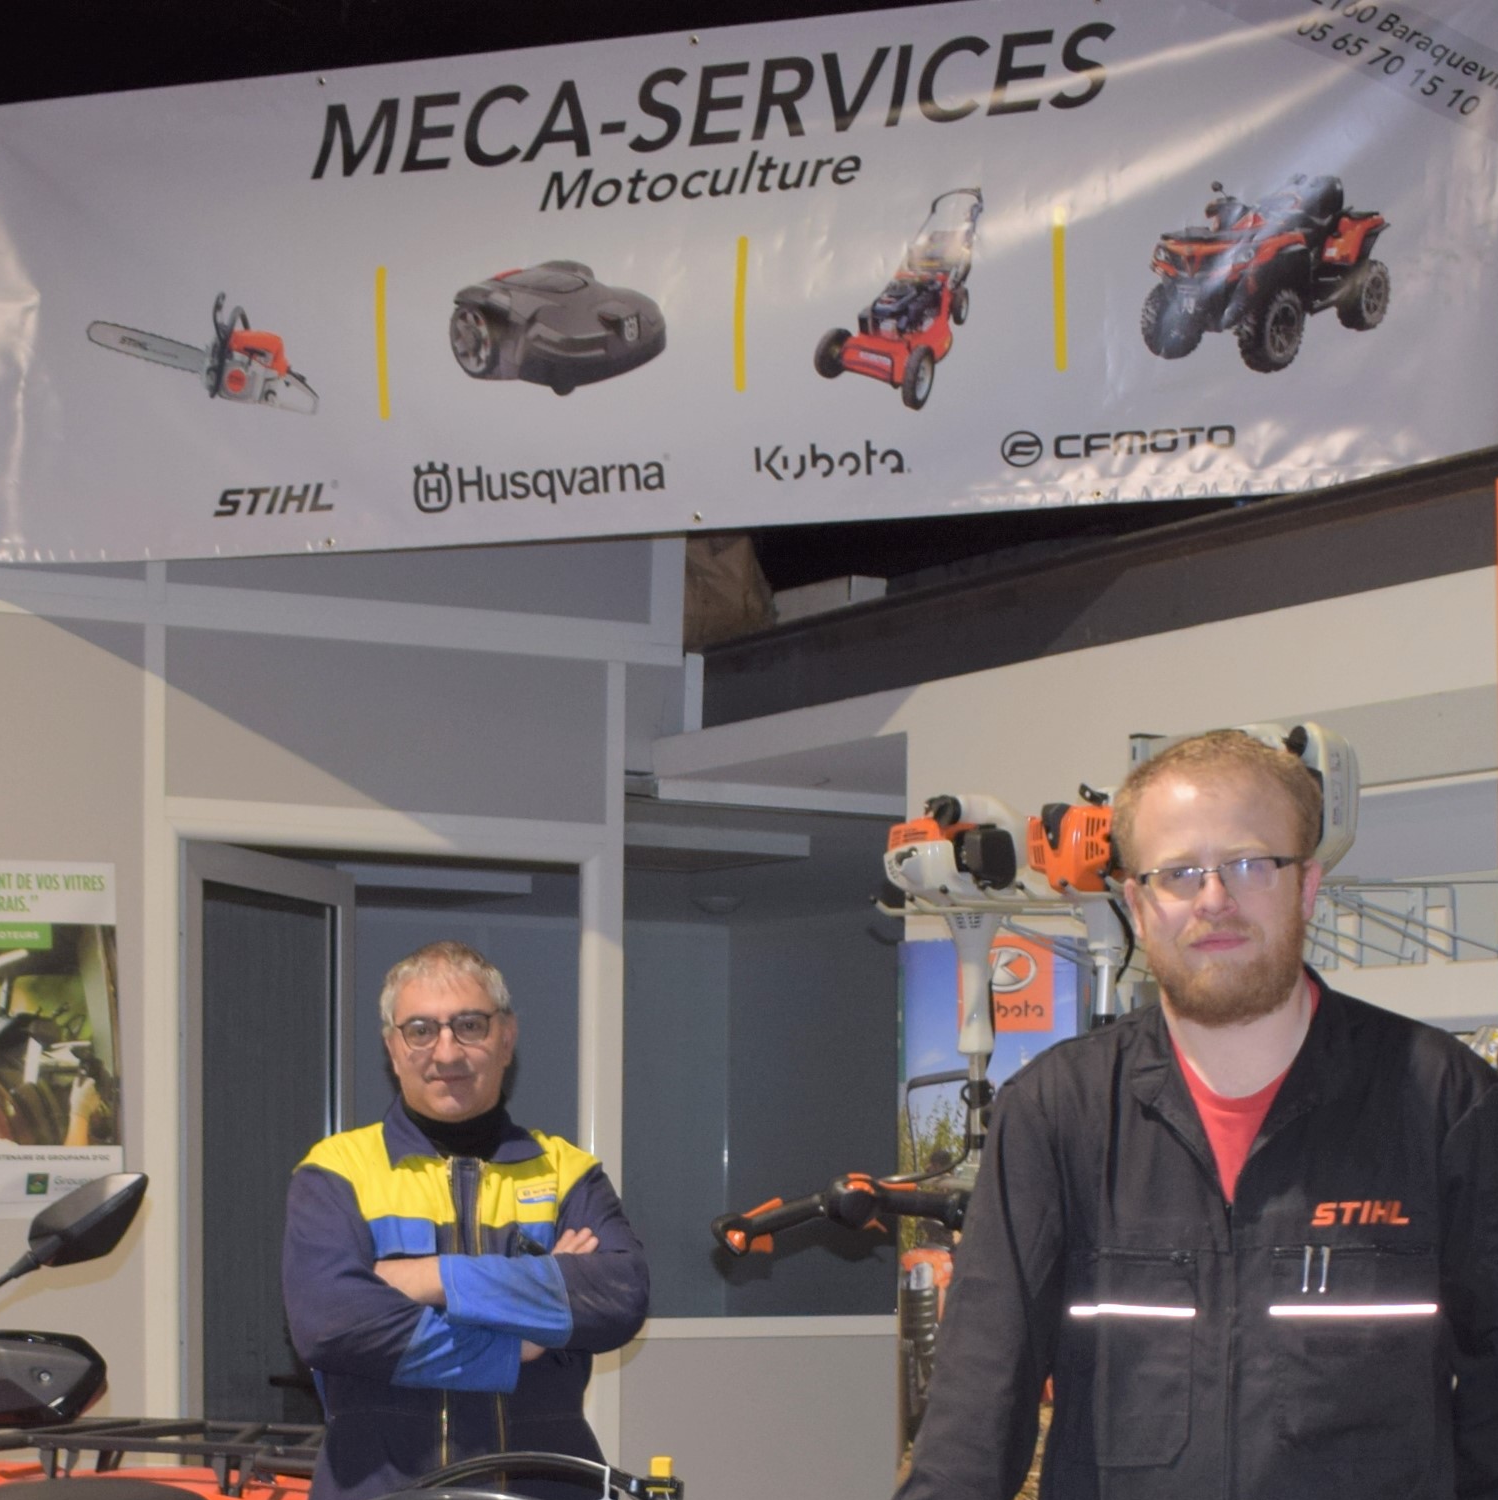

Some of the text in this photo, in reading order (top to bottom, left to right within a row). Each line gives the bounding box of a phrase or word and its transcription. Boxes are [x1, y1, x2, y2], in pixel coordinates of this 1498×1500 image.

[1331, 33, 1369, 58] 65
[1367, 47, 1406, 76] 70
[1408, 68, 1445, 97] 15
[1446, 87, 1481, 116] 10
[310, 21, 1117, 181] MECA-SERVICES
[539, 148, 862, 212] Motoculture
[755, 441, 906, 481] Kubota
[1053, 424, 1236, 461] CFMOTO
[213, 482, 335, 517] STIHL
[456, 459, 666, 505] Husqvarna
[16, 873, 33, 889] DE
[36, 874, 60, 890] VOS
[62, 874, 106, 892] VITRES
[1311, 1200, 1410, 1226] STIHL
